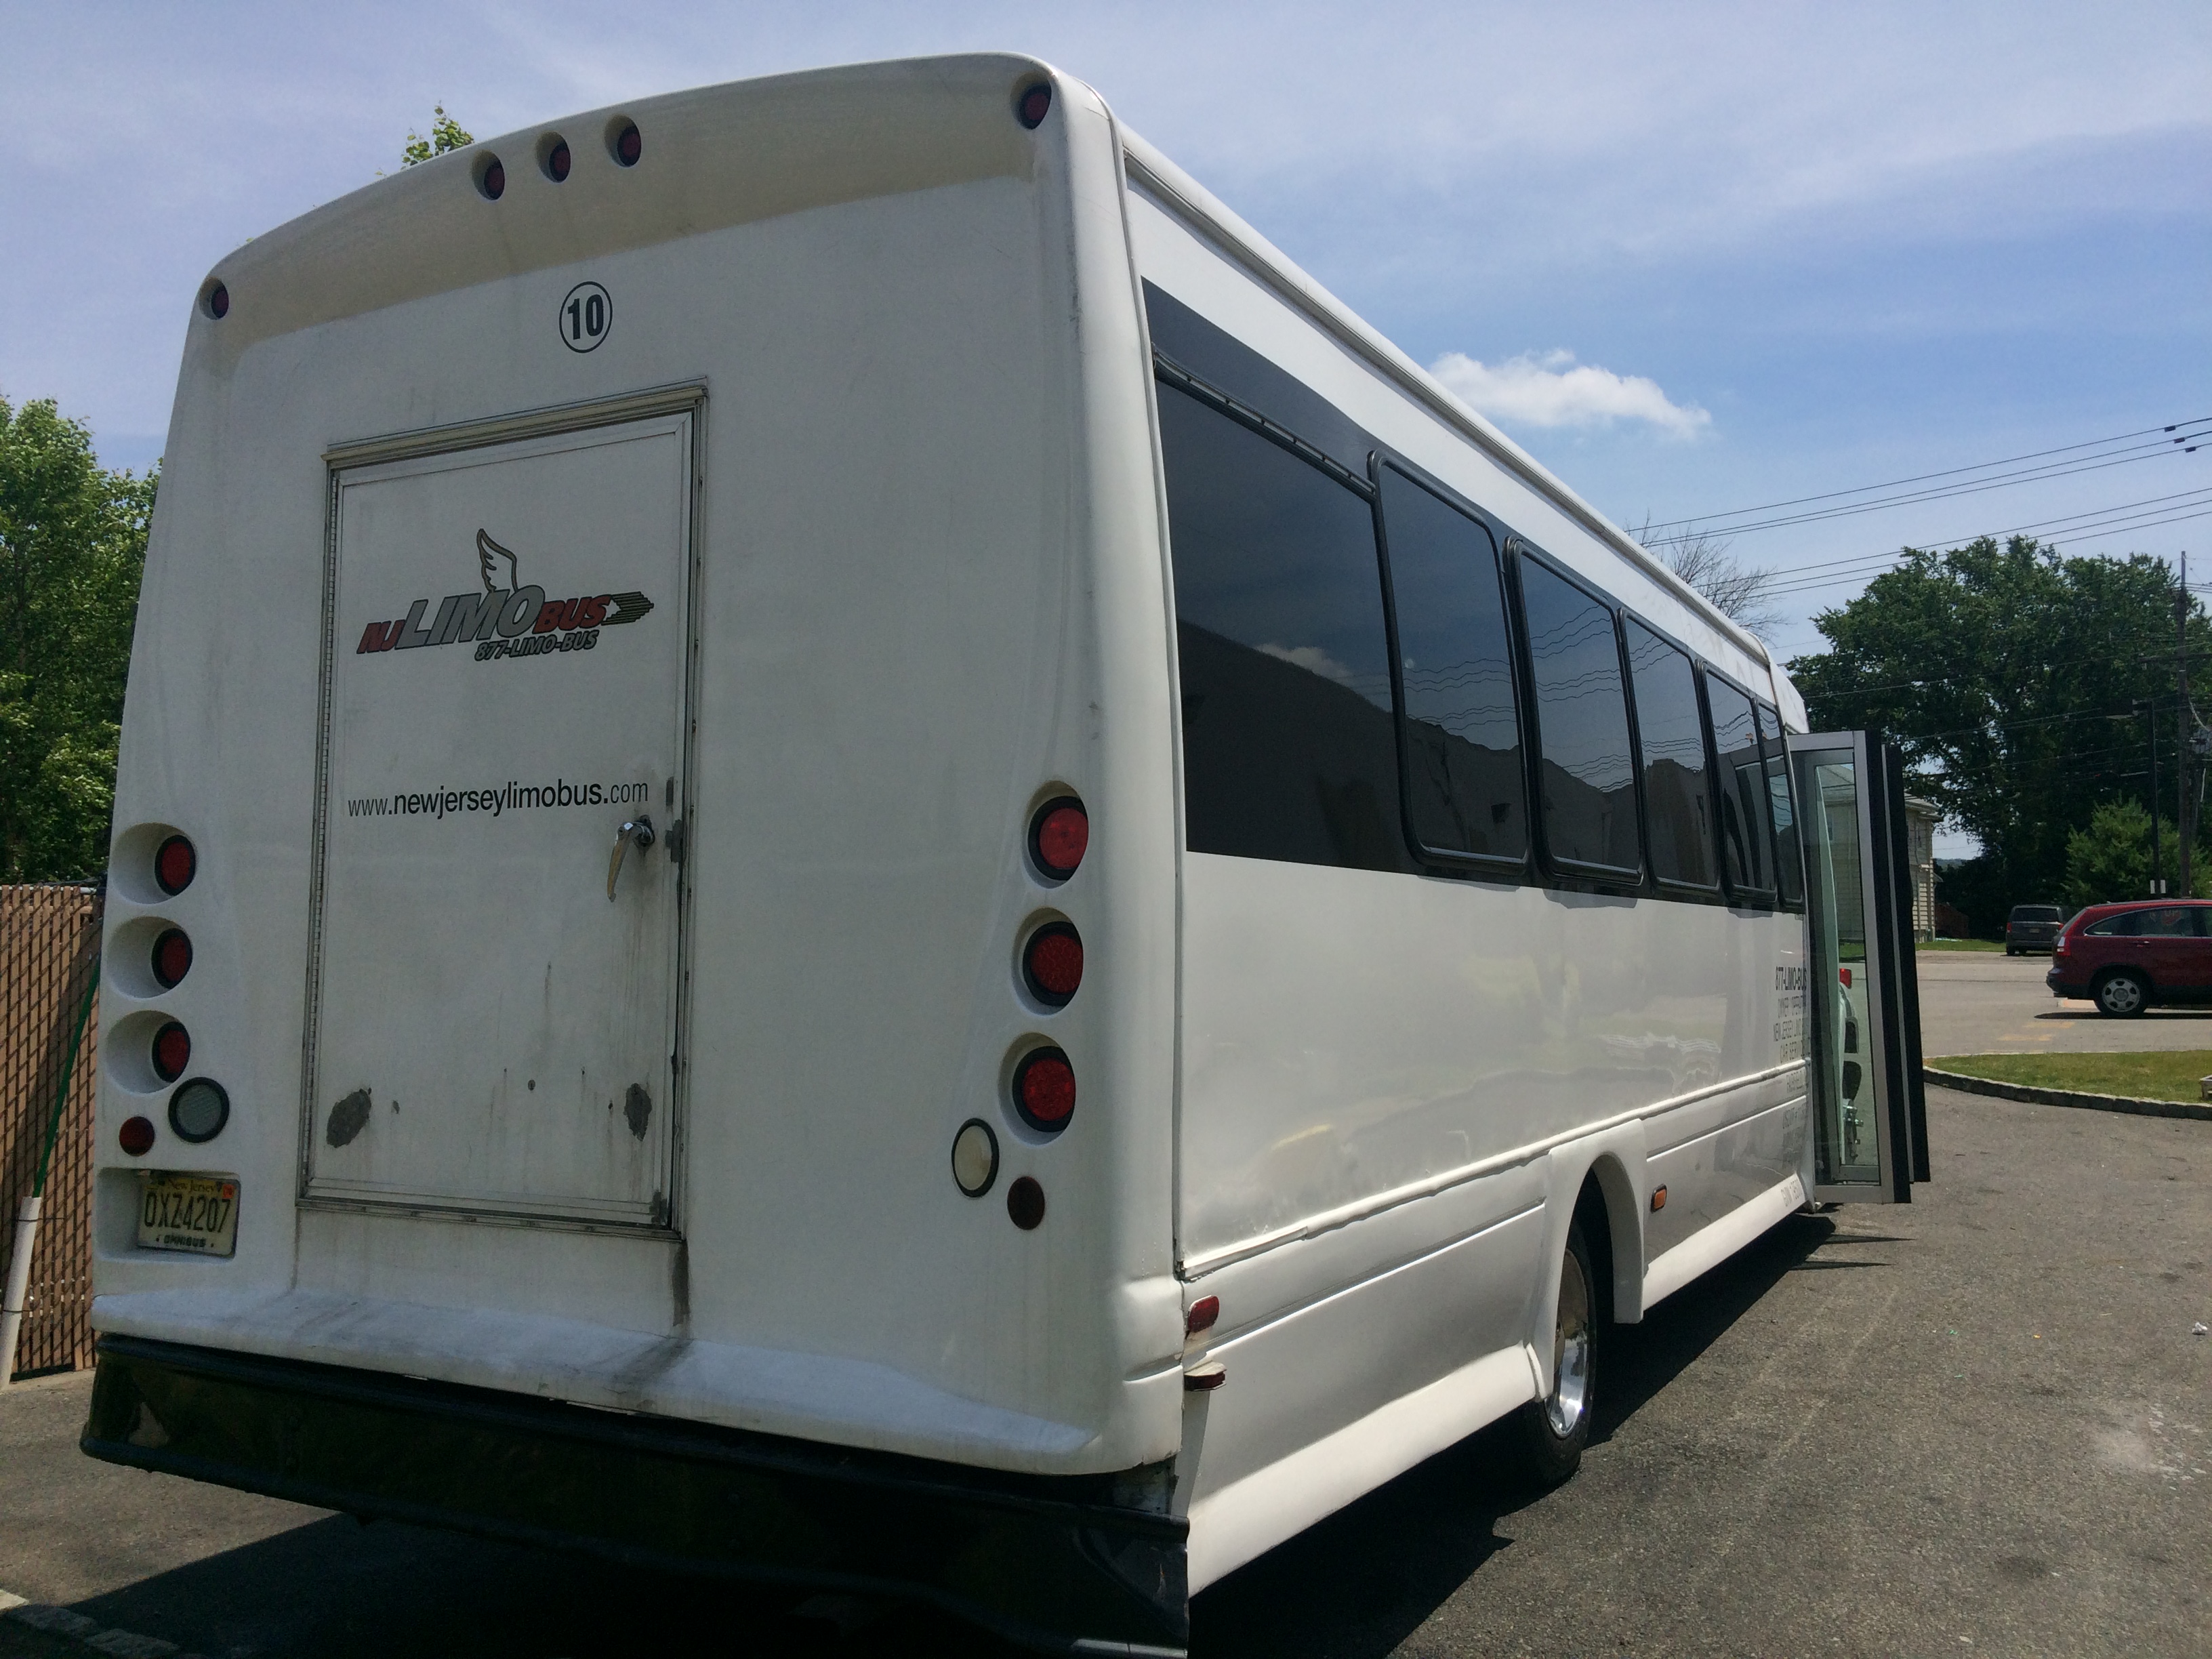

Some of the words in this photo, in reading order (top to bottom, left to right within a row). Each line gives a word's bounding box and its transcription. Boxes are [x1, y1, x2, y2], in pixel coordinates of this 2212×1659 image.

[567, 293, 605, 340] 10
[474, 630, 600, 661] 877-LIMO-BUS
[348, 779, 649, 820] www.newjerseylimobus.com
